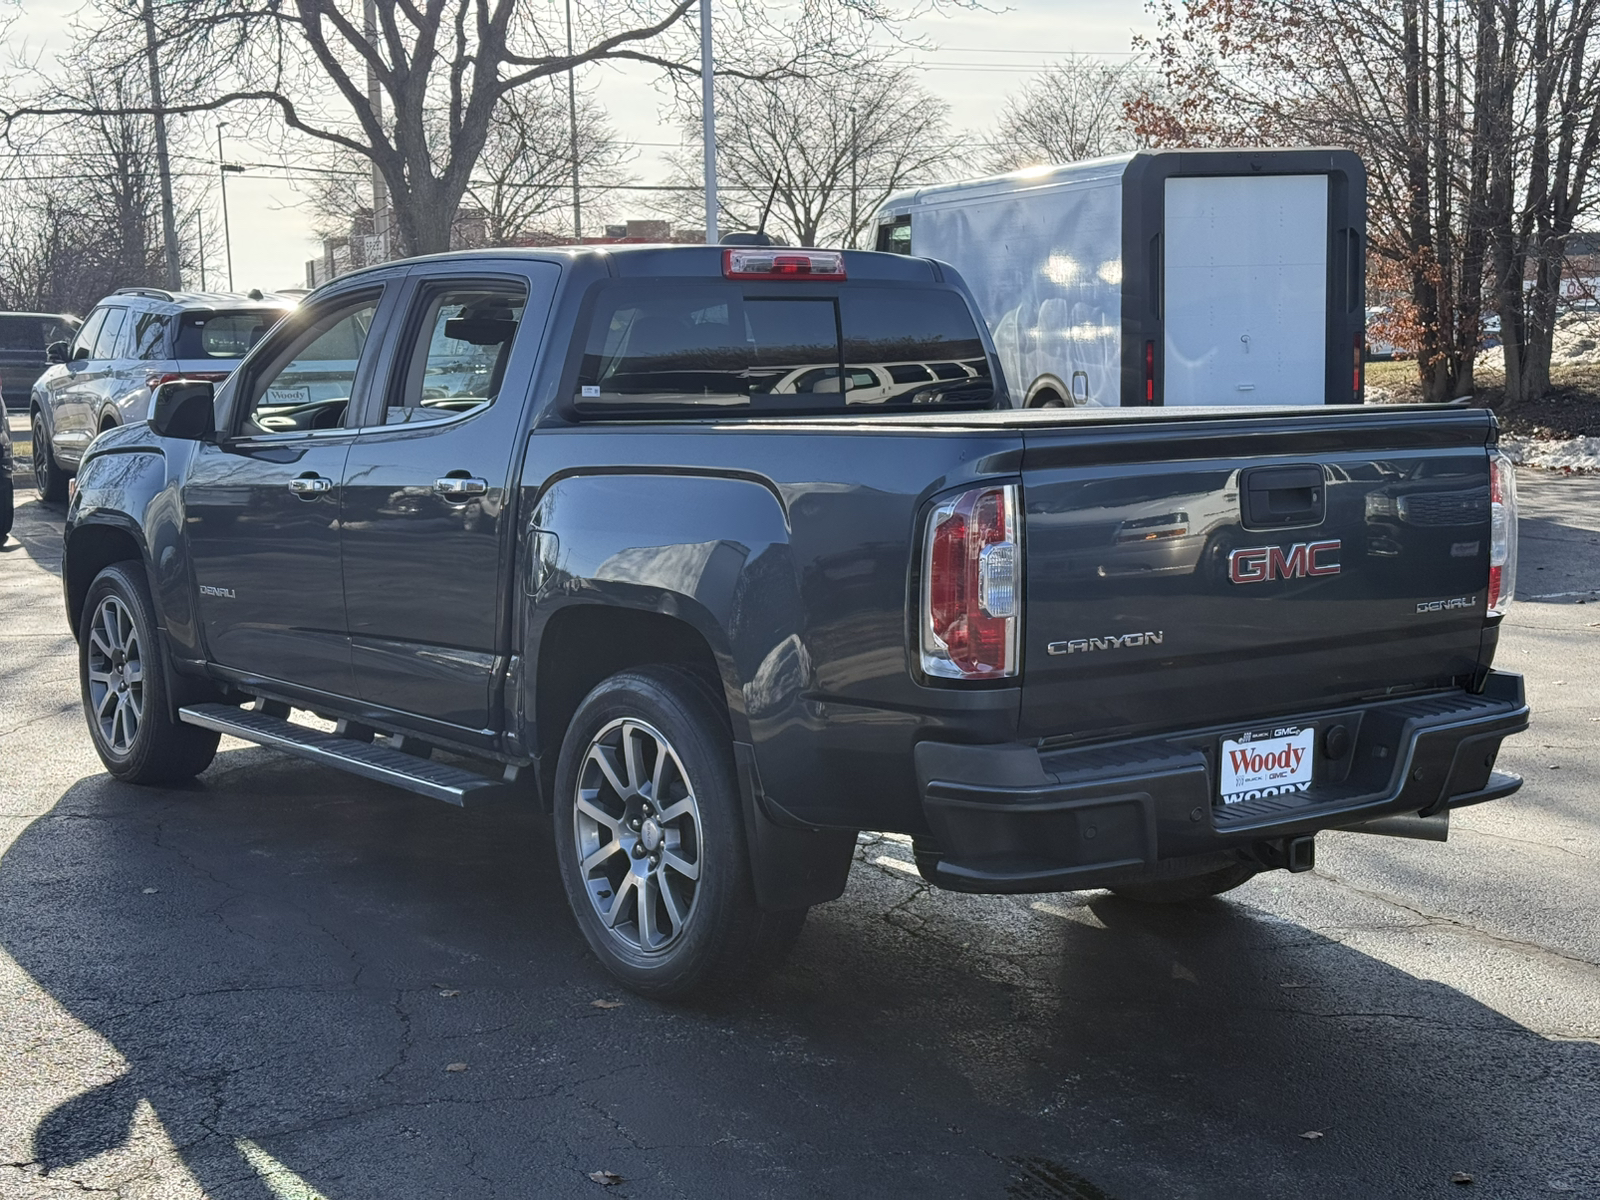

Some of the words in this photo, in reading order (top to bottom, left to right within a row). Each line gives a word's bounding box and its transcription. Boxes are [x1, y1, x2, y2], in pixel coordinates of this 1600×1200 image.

[271, 391, 305, 400] Woody
[1228, 539, 1341, 584] GMC
[199, 585, 235, 598] DENALI
[1416, 596, 1477, 613] DENALI
[1047, 630, 1163, 656] CANYON
[1274, 727, 1297, 737] GMC
[1229, 743, 1306, 775] Woody
[1269, 772, 1287, 780] GMC
